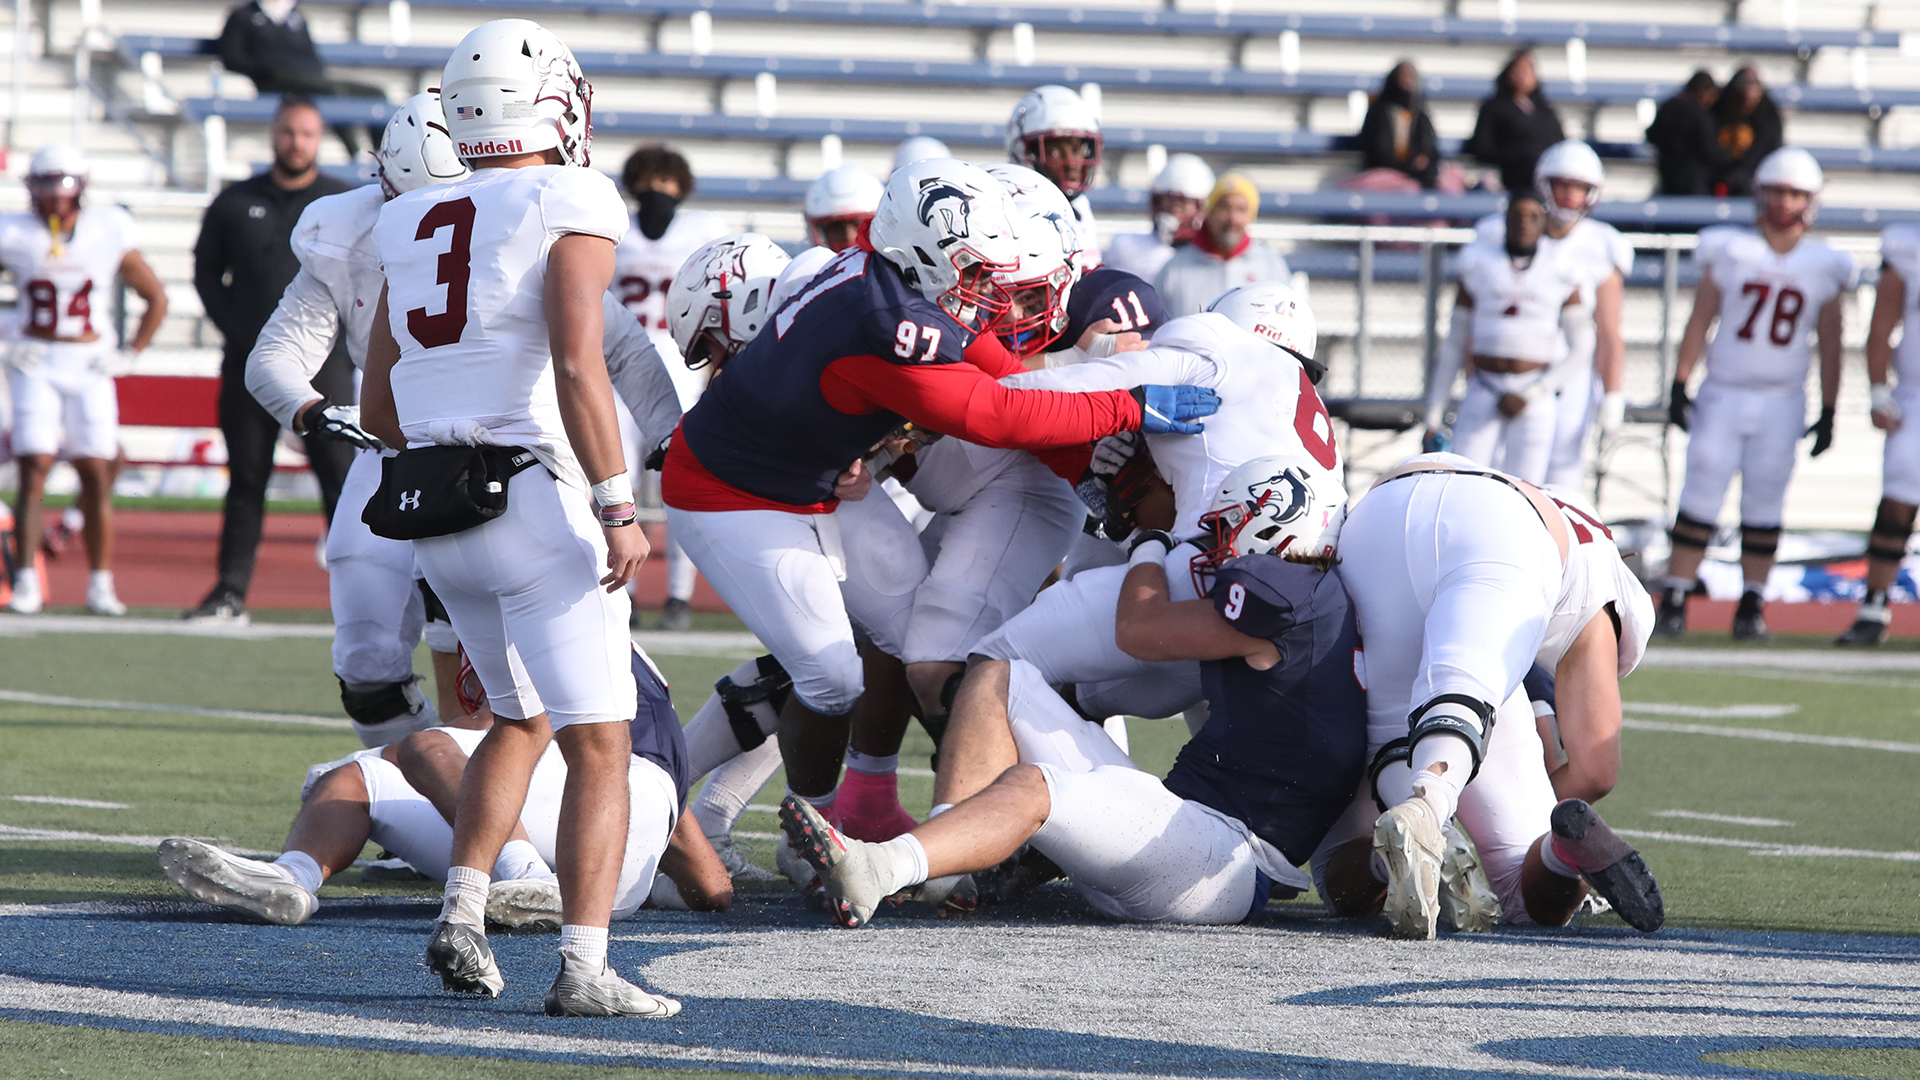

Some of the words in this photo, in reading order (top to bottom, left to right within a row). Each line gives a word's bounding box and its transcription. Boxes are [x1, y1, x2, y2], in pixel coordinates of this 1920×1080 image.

[458, 139, 523, 156] Riddell
[406, 195, 477, 349] 3
[27, 279, 93, 336] 84
[1111, 290, 1151, 332] 11
[1737, 283, 1805, 346] 78
[894, 319, 942, 361] 97
[1224, 581, 1246, 621] 9
